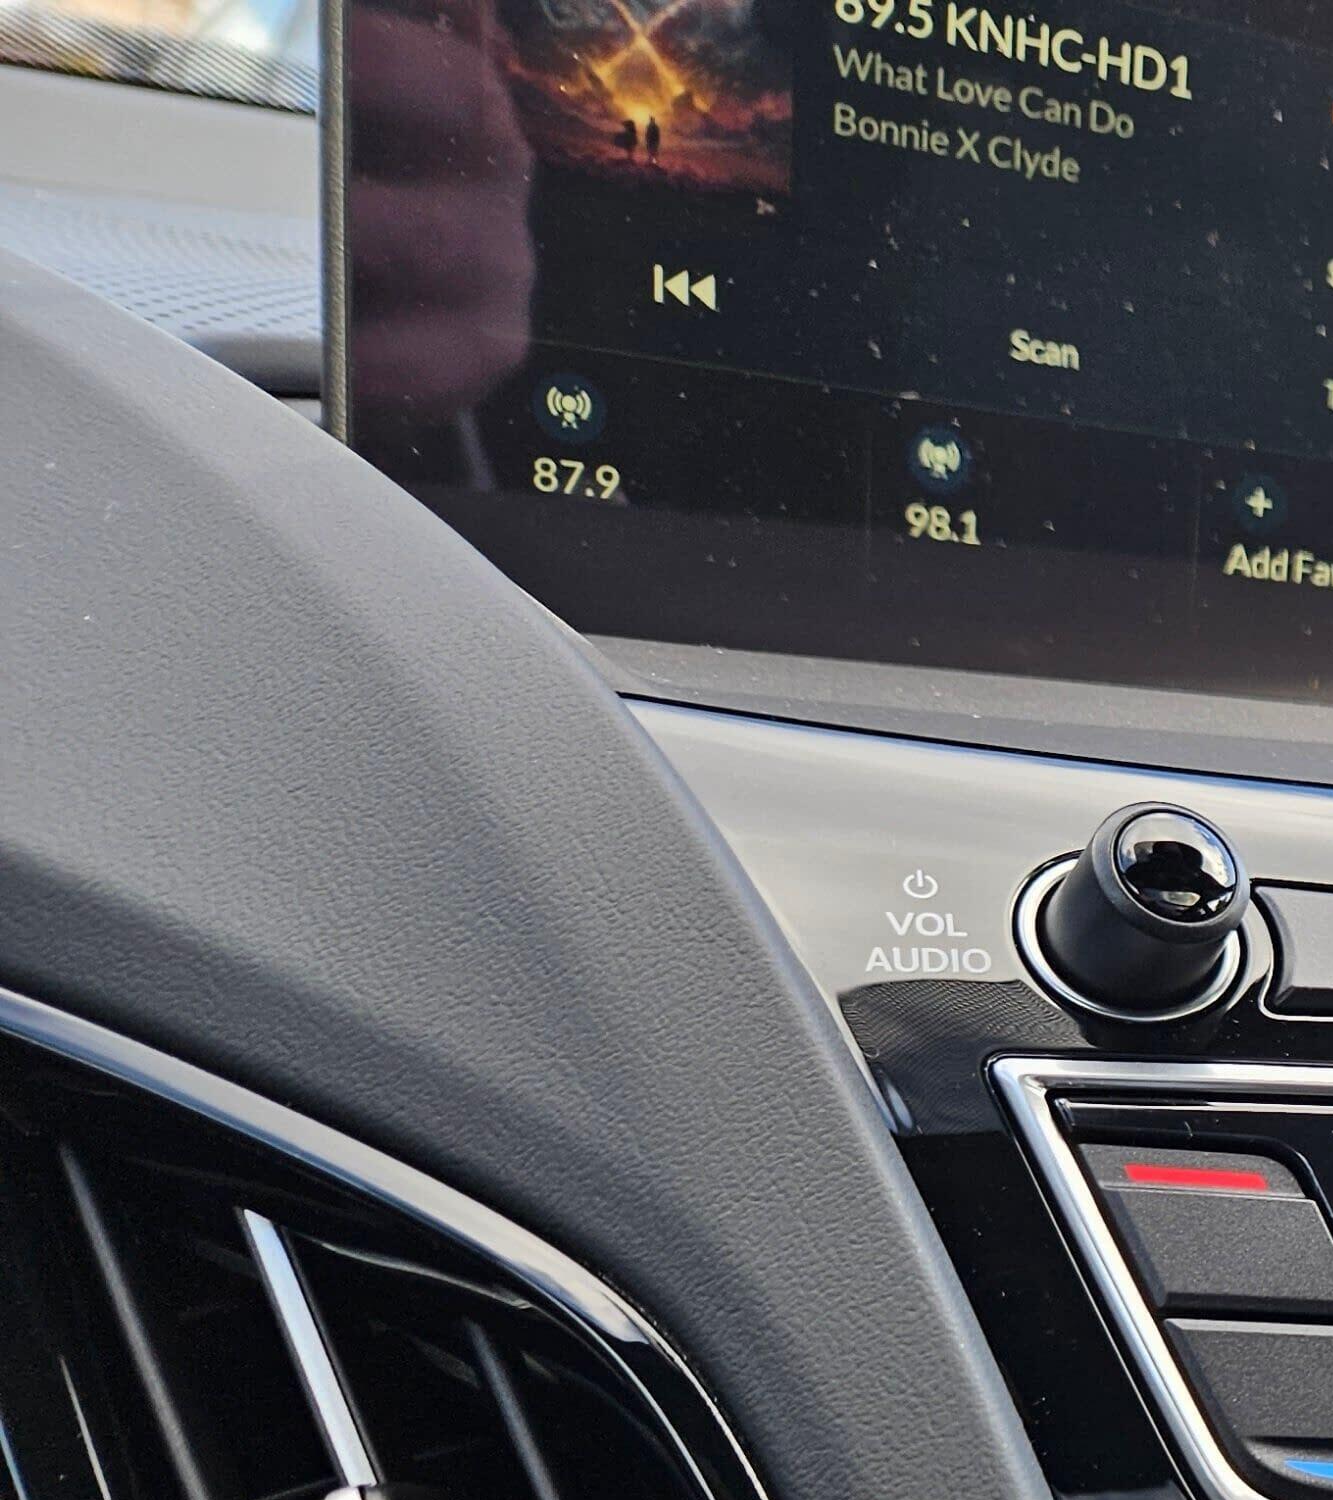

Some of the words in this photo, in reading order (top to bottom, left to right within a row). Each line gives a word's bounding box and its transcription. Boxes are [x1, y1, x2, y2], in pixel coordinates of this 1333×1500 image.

[946, 2, 1193, 100] KNHC-HD1
[833, 44, 928, 95] What
[937, 67, 1012, 113] Love
[1019, 87, 1081, 129] Can
[1090, 102, 1135, 139] Do
[833, 102, 950, 156] Bonnie
[955, 128, 981, 163] X
[988, 136, 1081, 182] Clyde
[1010, 328, 1080, 371] Scan
[533, 457, 620, 498] 87.9
[905, 503, 981, 545] 98.1
[1223, 544, 1289, 582] Add
[886, 911, 968, 937] VOL
[865, 945, 992, 974] AUDIO
